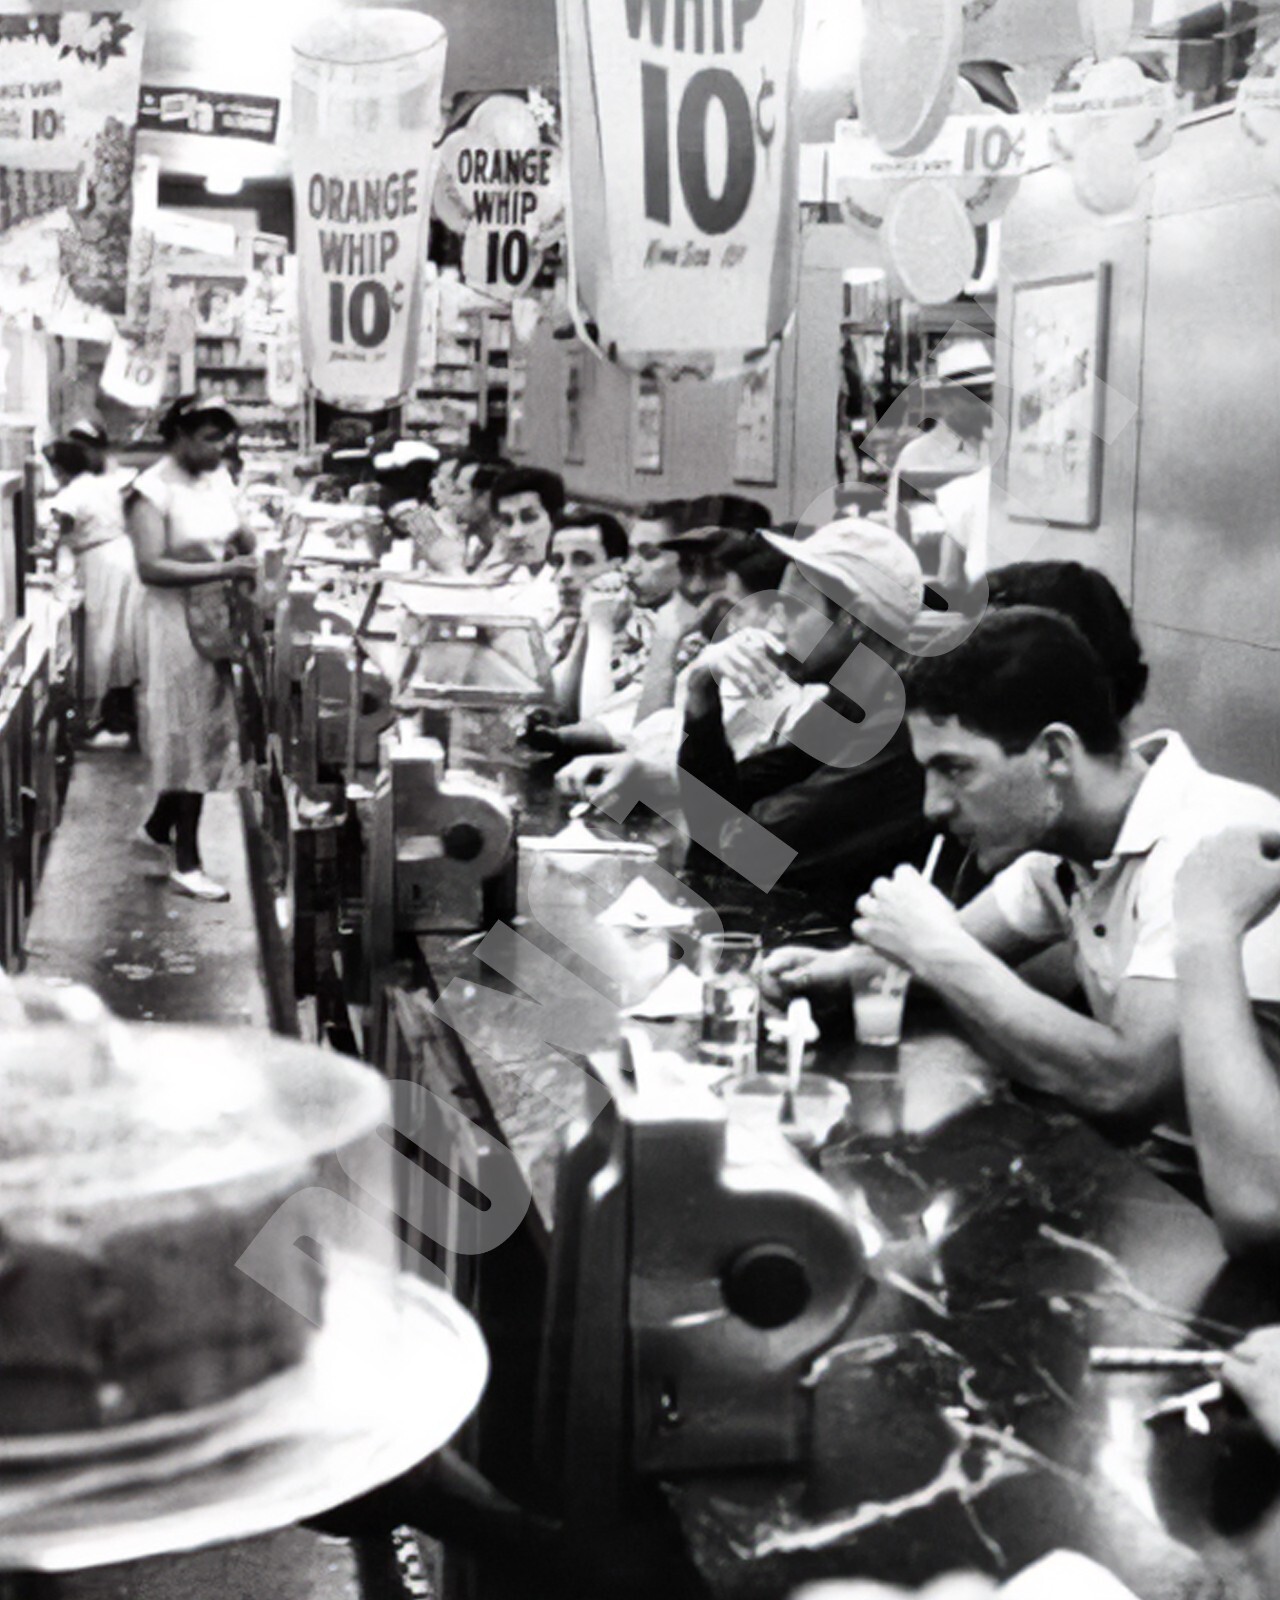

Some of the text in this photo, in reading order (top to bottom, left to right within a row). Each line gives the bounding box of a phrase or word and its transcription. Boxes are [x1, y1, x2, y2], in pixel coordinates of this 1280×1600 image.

[457, 148, 552, 186] ORANGE
[308, 169, 419, 223] ORANGE
[473, 190, 537, 225] WHIP
[318, 230, 399, 276] WHIP
[486, 230, 529, 286] 10
